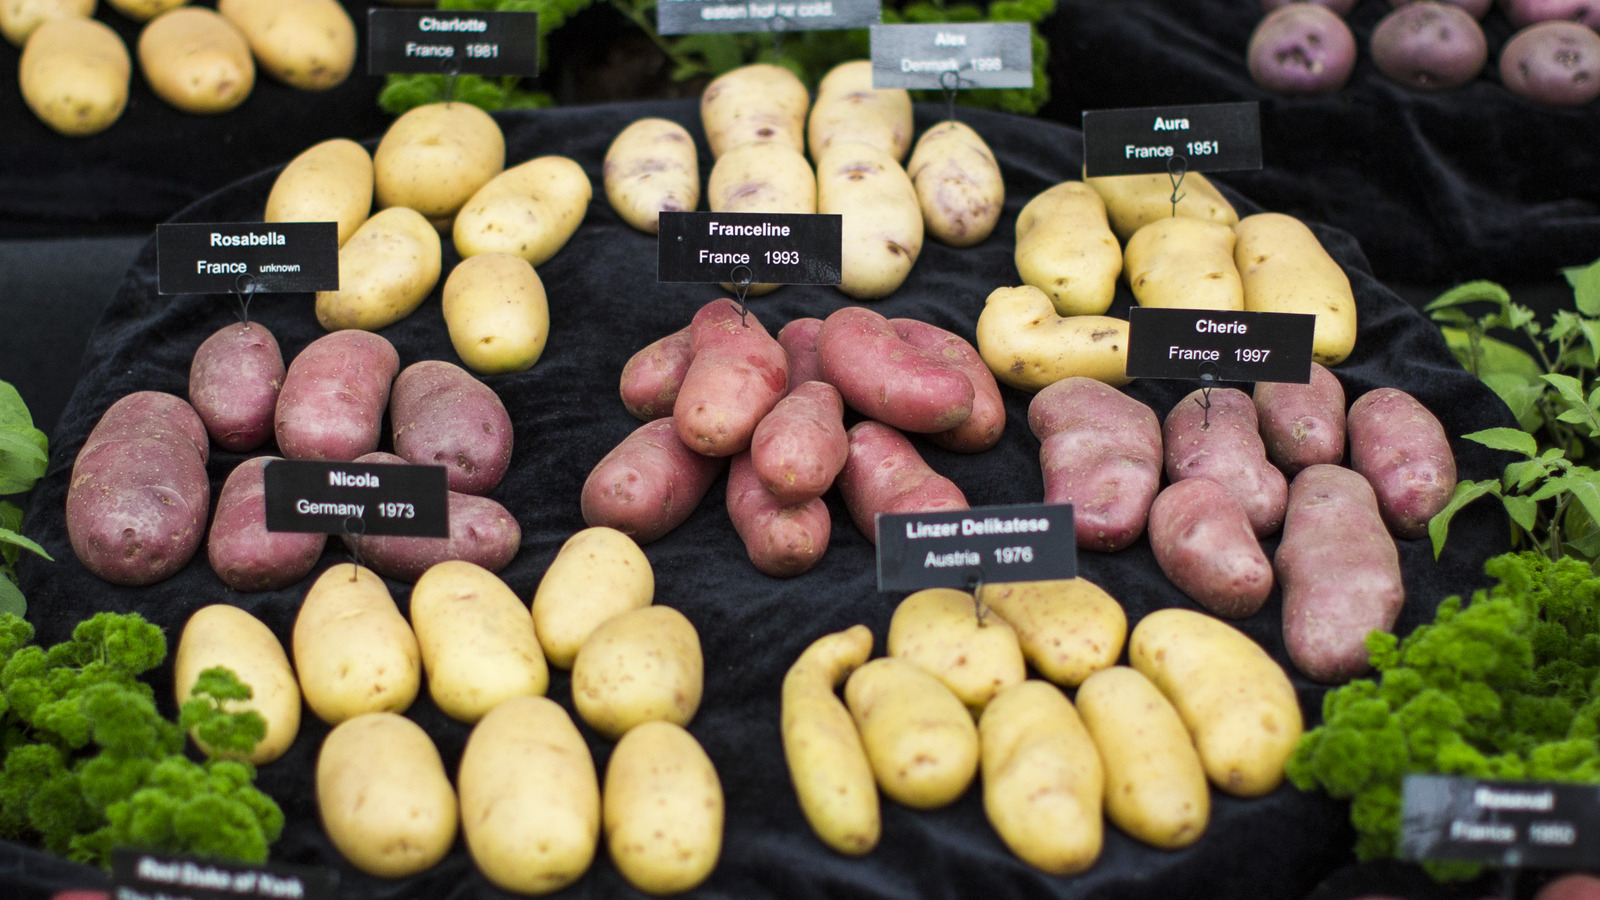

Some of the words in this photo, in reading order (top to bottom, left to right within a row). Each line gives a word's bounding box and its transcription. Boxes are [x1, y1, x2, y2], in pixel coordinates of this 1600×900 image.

[700, 4, 748, 20] eaten
[750, 2, 776, 18] hot
[777, 5, 797, 18] or
[798, 2, 836, 17] cold.
[419, 17, 487, 32] Charlotte
[935, 31, 967, 46] Alex
[405, 42, 454, 57] France
[466, 43, 498, 58] 1981
[900, 57, 961, 72] Denmark
[970, 55, 1002, 72] 1998
[1153, 116, 1190, 131] Aura
[1125, 144, 1174, 159] France
[1186, 140, 1219, 155] 1951
[709, 221, 791, 237] Franceline
[210, 231, 286, 247] Rosabella
[699, 249, 750, 264] France
[764, 250, 800, 265] 1993
[197, 260, 247, 274] France
[259, 263, 301, 273] unknown
[1195, 319, 1248, 335] Cherie
[1168, 345, 1220, 361] France
[1234, 348, 1271, 363] 1997
[329, 471, 380, 488] Nicola
[296, 498, 365, 518] Germany
[378, 502, 415, 519] 1973
[905, 520, 960, 540] Linzer
[961, 516, 1050, 538] Delikatese
[923, 551, 981, 568] Austria
[993, 545, 1034, 564] 1976
